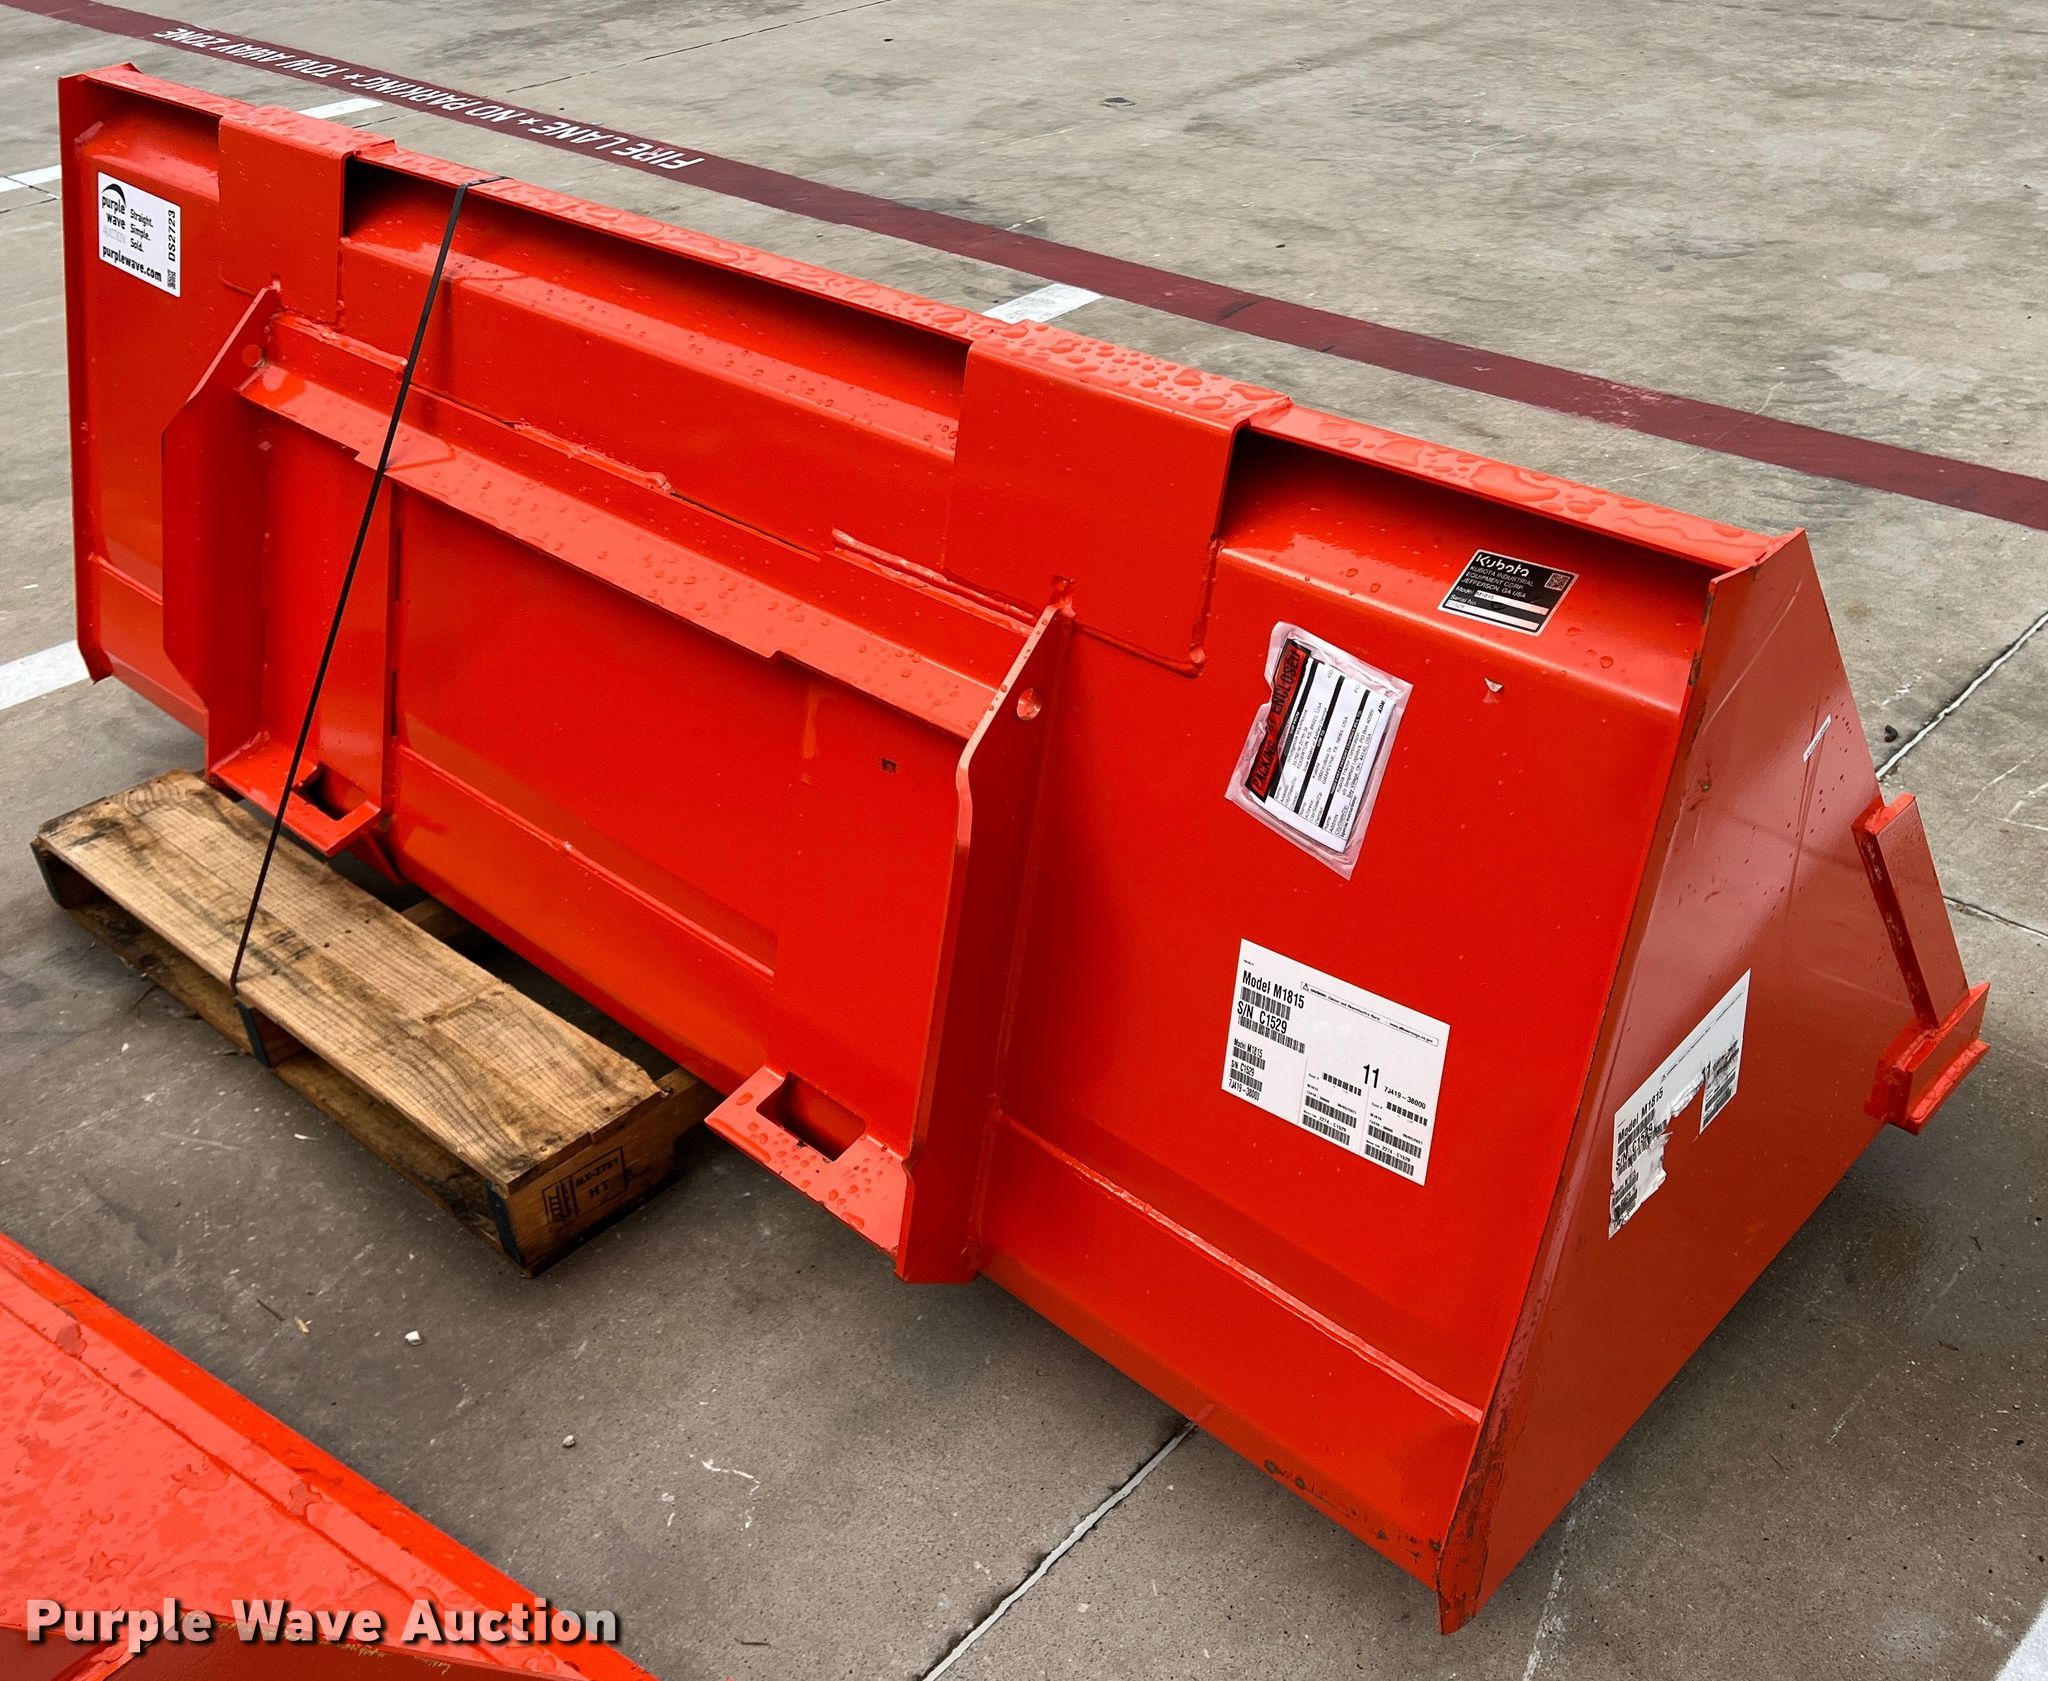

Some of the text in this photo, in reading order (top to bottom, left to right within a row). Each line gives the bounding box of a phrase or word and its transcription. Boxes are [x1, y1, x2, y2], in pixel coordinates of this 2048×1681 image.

[153, 28, 349, 78] TOW AWAY ZONE
[351, 74, 524, 123] NO PARKING
[528, 121, 705, 170] FIRE LANE
[102, 196, 125, 214] purple
[106, 213, 125, 229] wave
[130, 208, 153, 228] Straight.
[130, 224, 151, 241] Simple.
[168, 210, 176, 262] DS2723
[130, 238, 144, 253] Sold.
[103, 246, 162, 282] purplewave.com
[1468, 565, 1535, 586] KUBOTA INDUSTRIAL
[1475, 553, 1530, 577] Kubota
[1465, 571, 1504, 585] EQUIPMENT
[1511, 590, 1527, 598] USA
[1254, 740, 1278, 786] PACKING
[1272, 651, 1301, 715] ENCLOSED
[1242, 969, 1305, 1009] Model M1815
[1236, 999, 1287, 1034] S/N C1529
[1246, 1043, 1262, 1058] M1815
[1239, 1062, 1254, 1077] C1529
[1363, 1063, 1379, 1088] 11
[1617, 1110, 1639, 1145] Model
[1641, 1084, 1663, 1119] M1815
